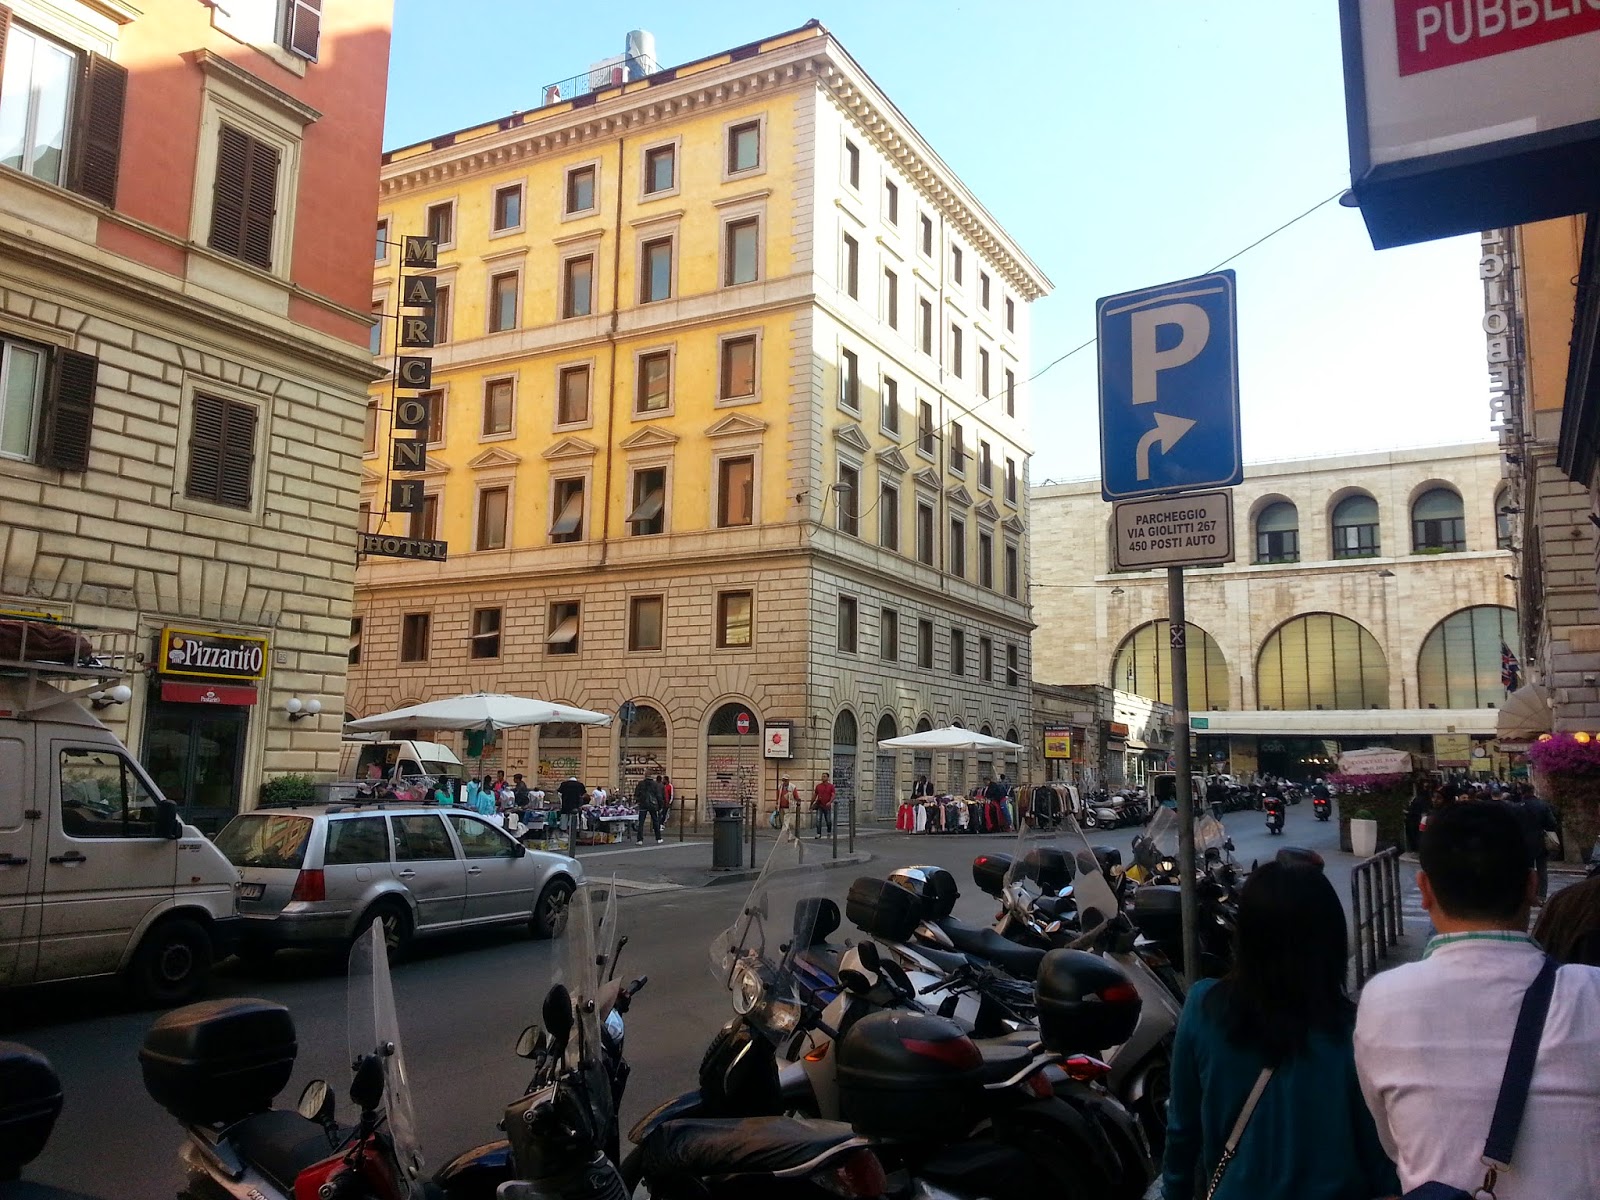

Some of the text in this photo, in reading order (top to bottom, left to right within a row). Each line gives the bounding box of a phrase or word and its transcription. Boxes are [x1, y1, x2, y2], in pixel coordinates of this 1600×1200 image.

[1416, 0, 1600, 52] PUBBL
[1131, 303, 1210, 405] P
[395, 238, 436, 508] MARCONI
[1127, 520, 1217, 539] VIA GIOLITTI 267
[1136, 508, 1206, 525] PARCHEGGIO
[364, 533, 447, 559] HOTEL
[1129, 534, 1216, 552] 450 POSTI AUTO
